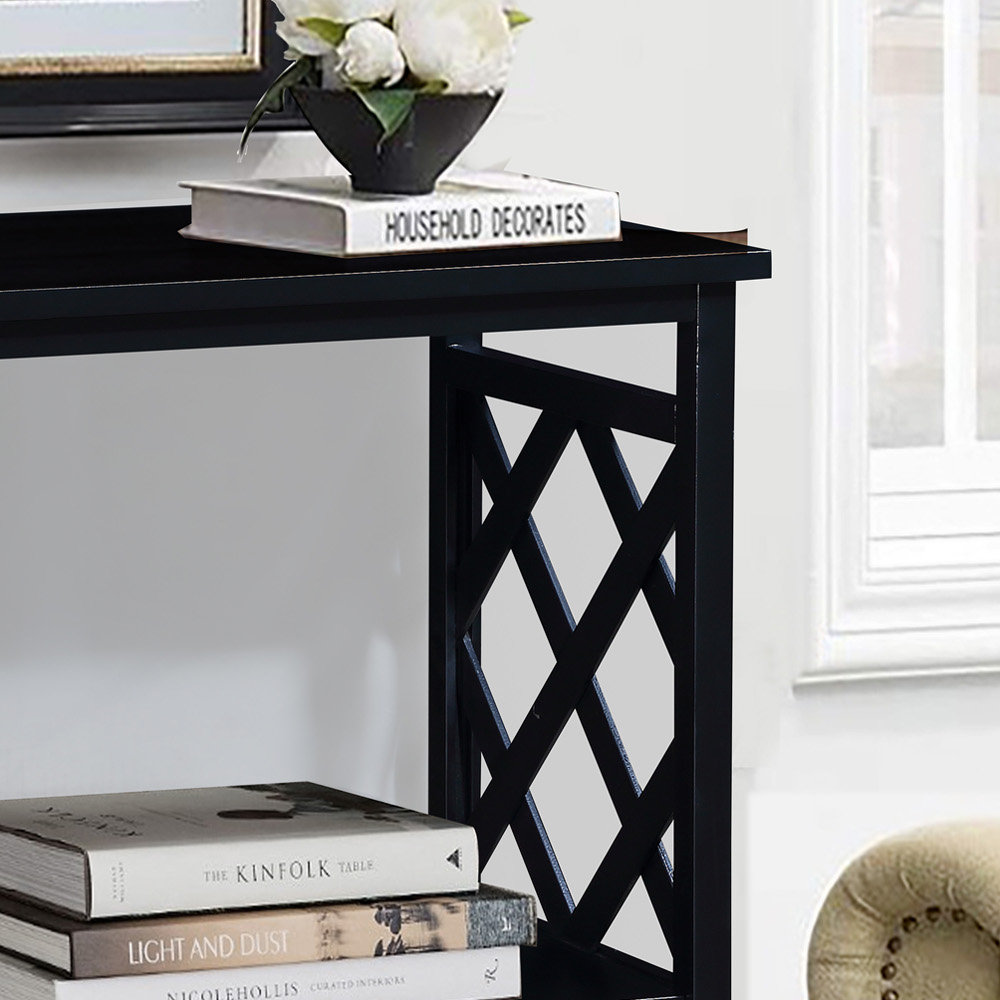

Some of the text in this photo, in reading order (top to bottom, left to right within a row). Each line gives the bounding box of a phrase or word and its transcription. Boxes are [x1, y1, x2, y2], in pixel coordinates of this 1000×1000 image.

[386, 203, 586, 242] HOUSEHOLD DECORATES
[204, 860, 374, 883] THE KINFOLK TABLE
[128, 930, 289, 965] LIGHT AND DUST
[309, 979, 354, 992] CURATED
